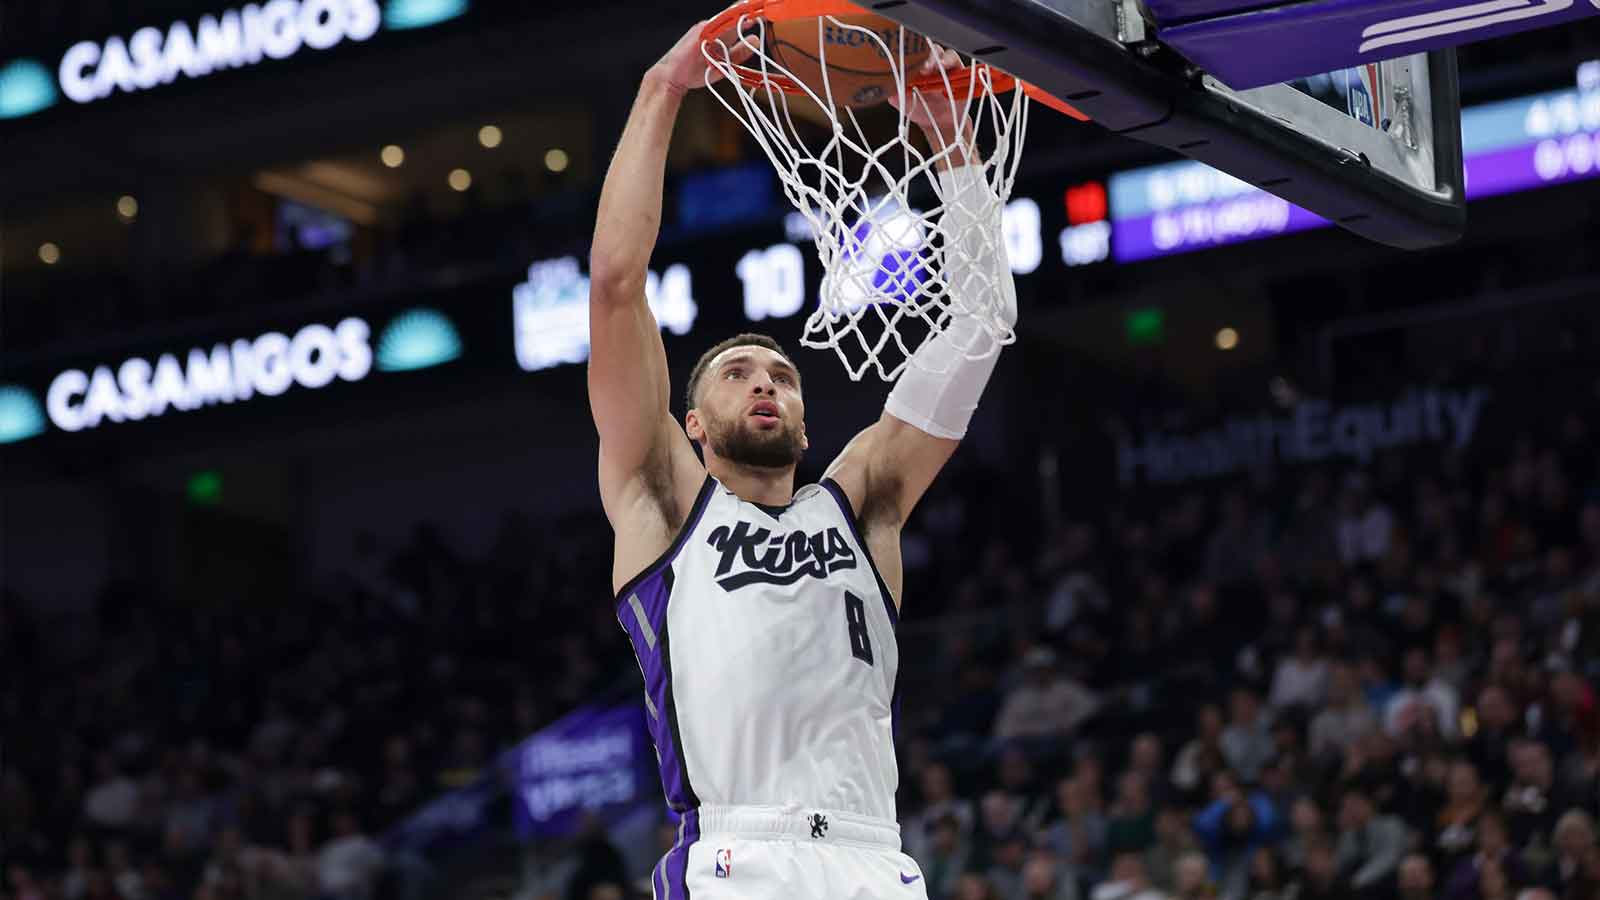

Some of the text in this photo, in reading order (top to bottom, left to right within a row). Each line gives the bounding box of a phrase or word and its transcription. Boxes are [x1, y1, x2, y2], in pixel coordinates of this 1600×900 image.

[59, 0, 381, 102] CASAMIGOS
[737, 246, 804, 318] 10
[47, 317, 373, 431] CASAMIGOS
[706, 520, 857, 592] Kings
[844, 590, 874, 666] 8
